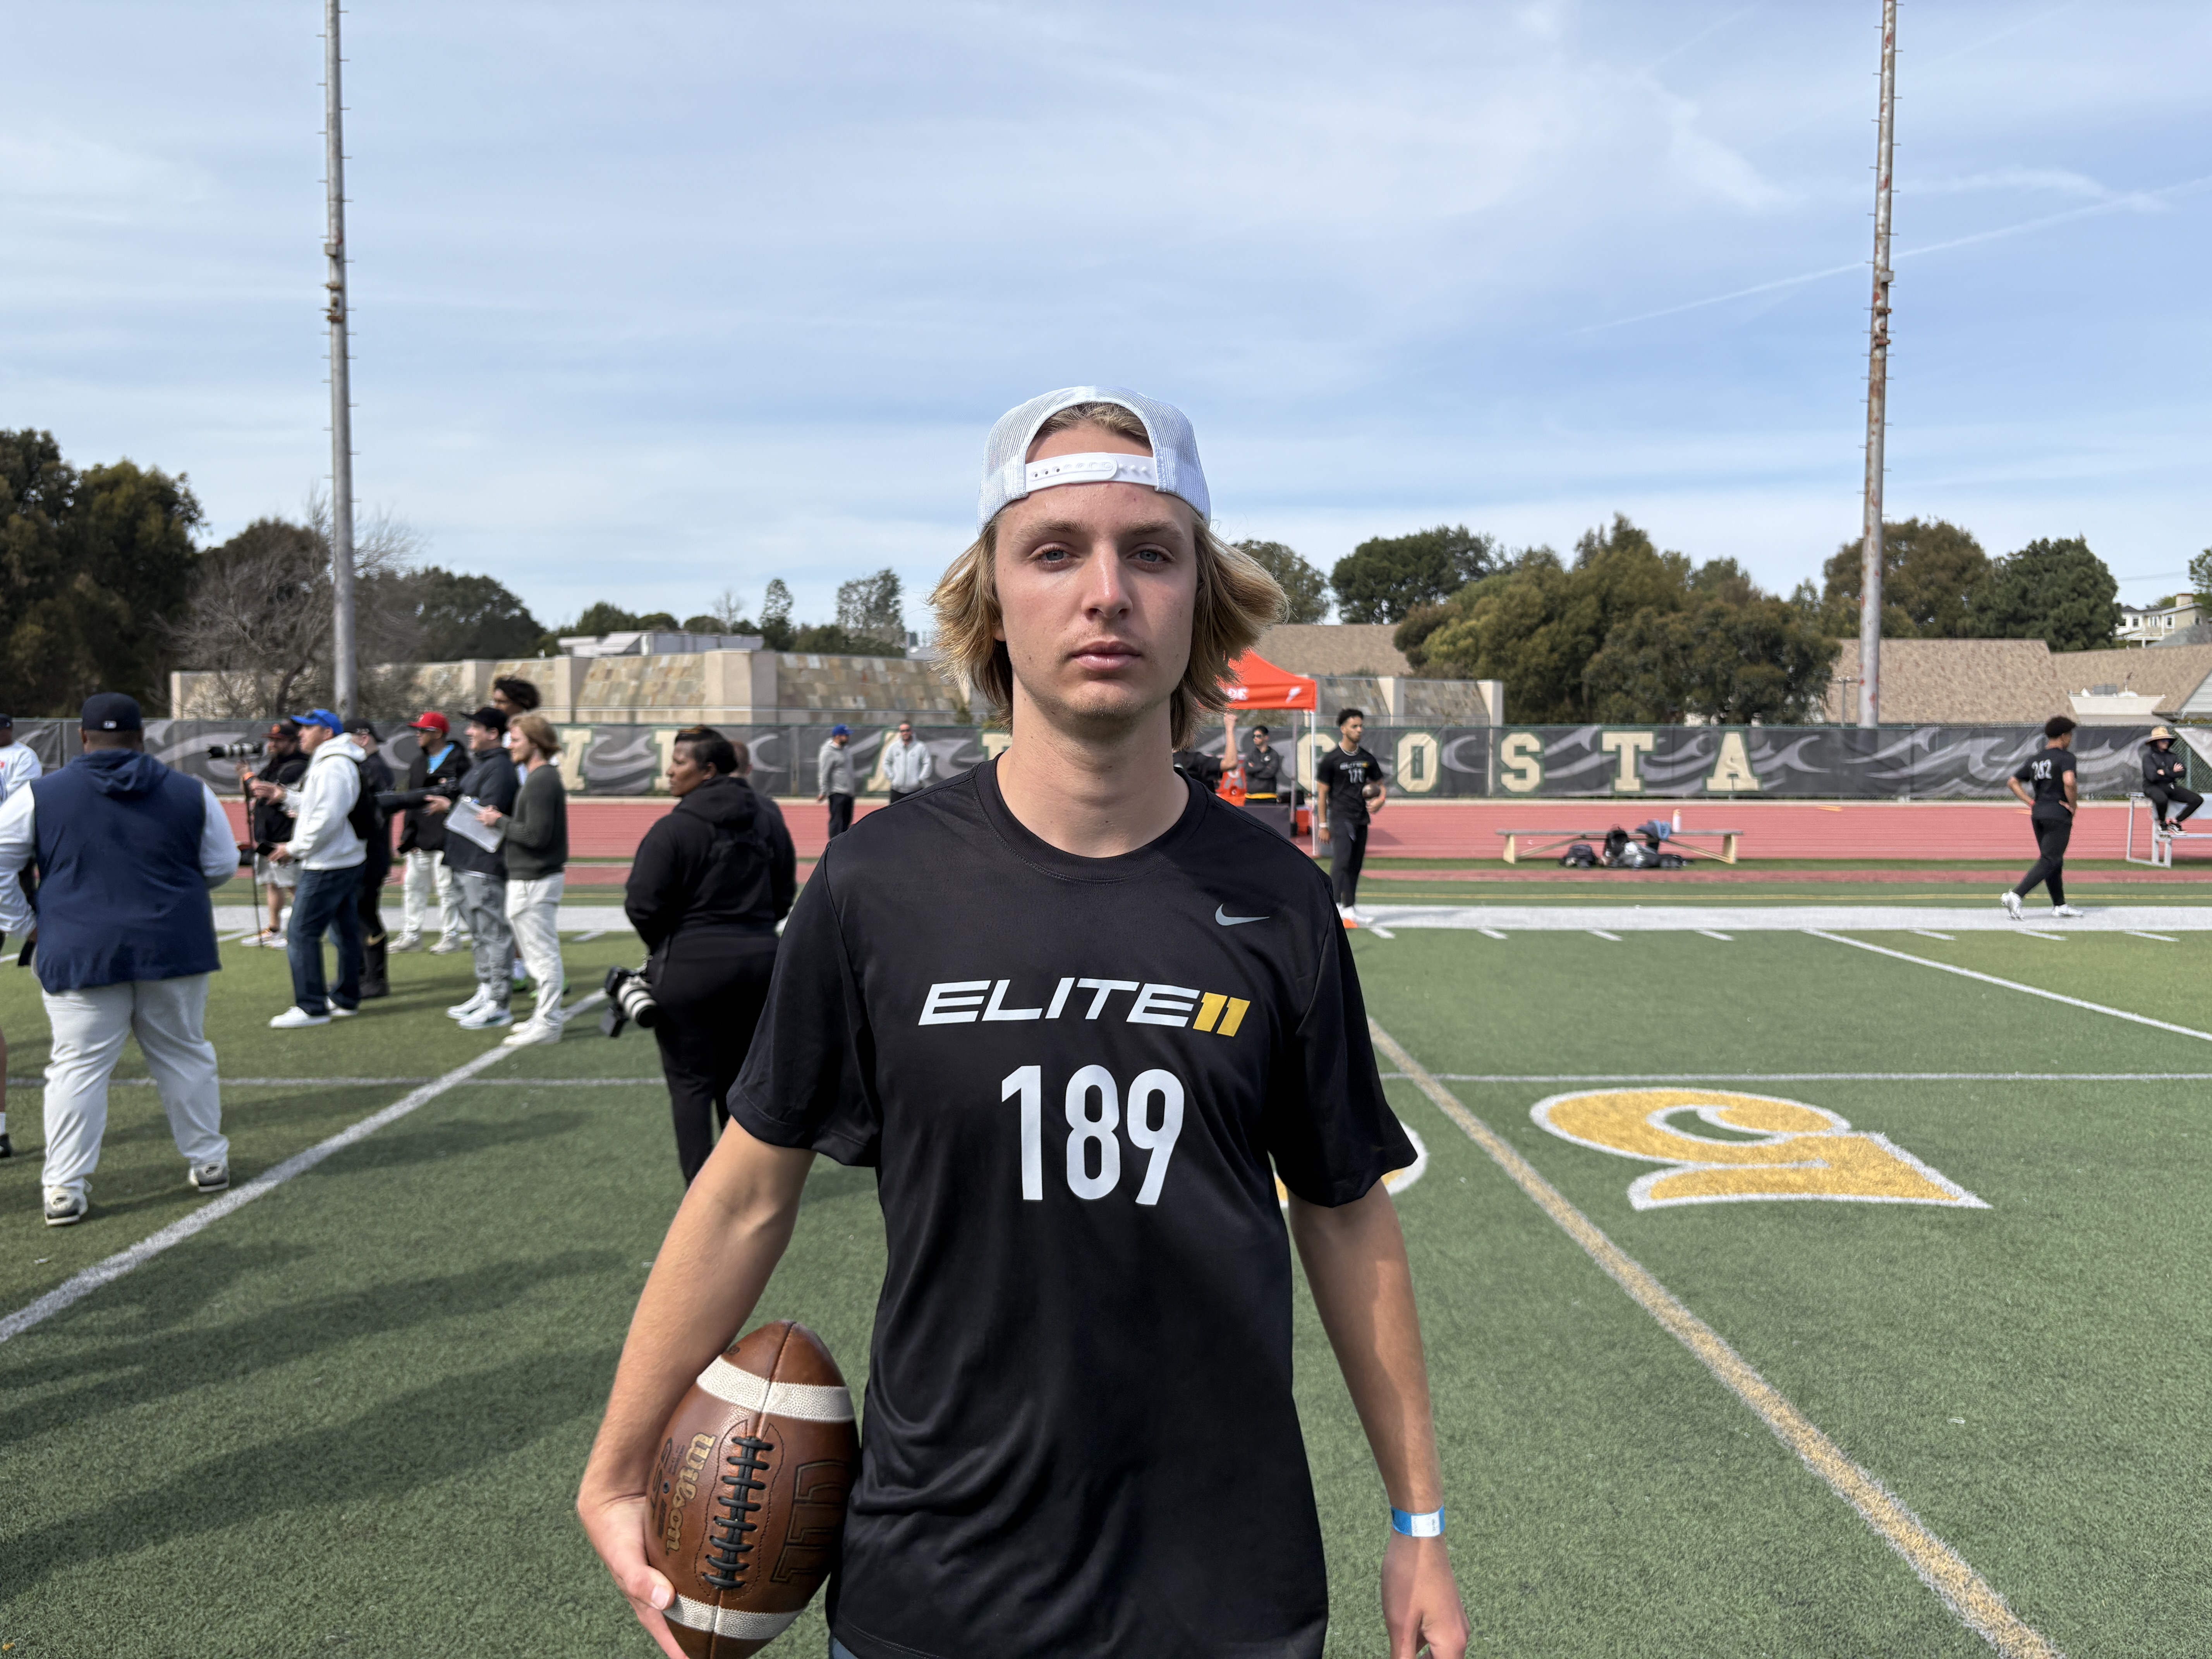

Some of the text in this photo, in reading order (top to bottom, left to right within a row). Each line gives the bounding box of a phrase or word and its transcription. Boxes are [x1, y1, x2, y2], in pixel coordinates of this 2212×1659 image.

[1297, 731, 1761, 792] COSTA
[1001, 1064, 1184, 1205] 189
[666, 1432, 717, 1551] Wilson
